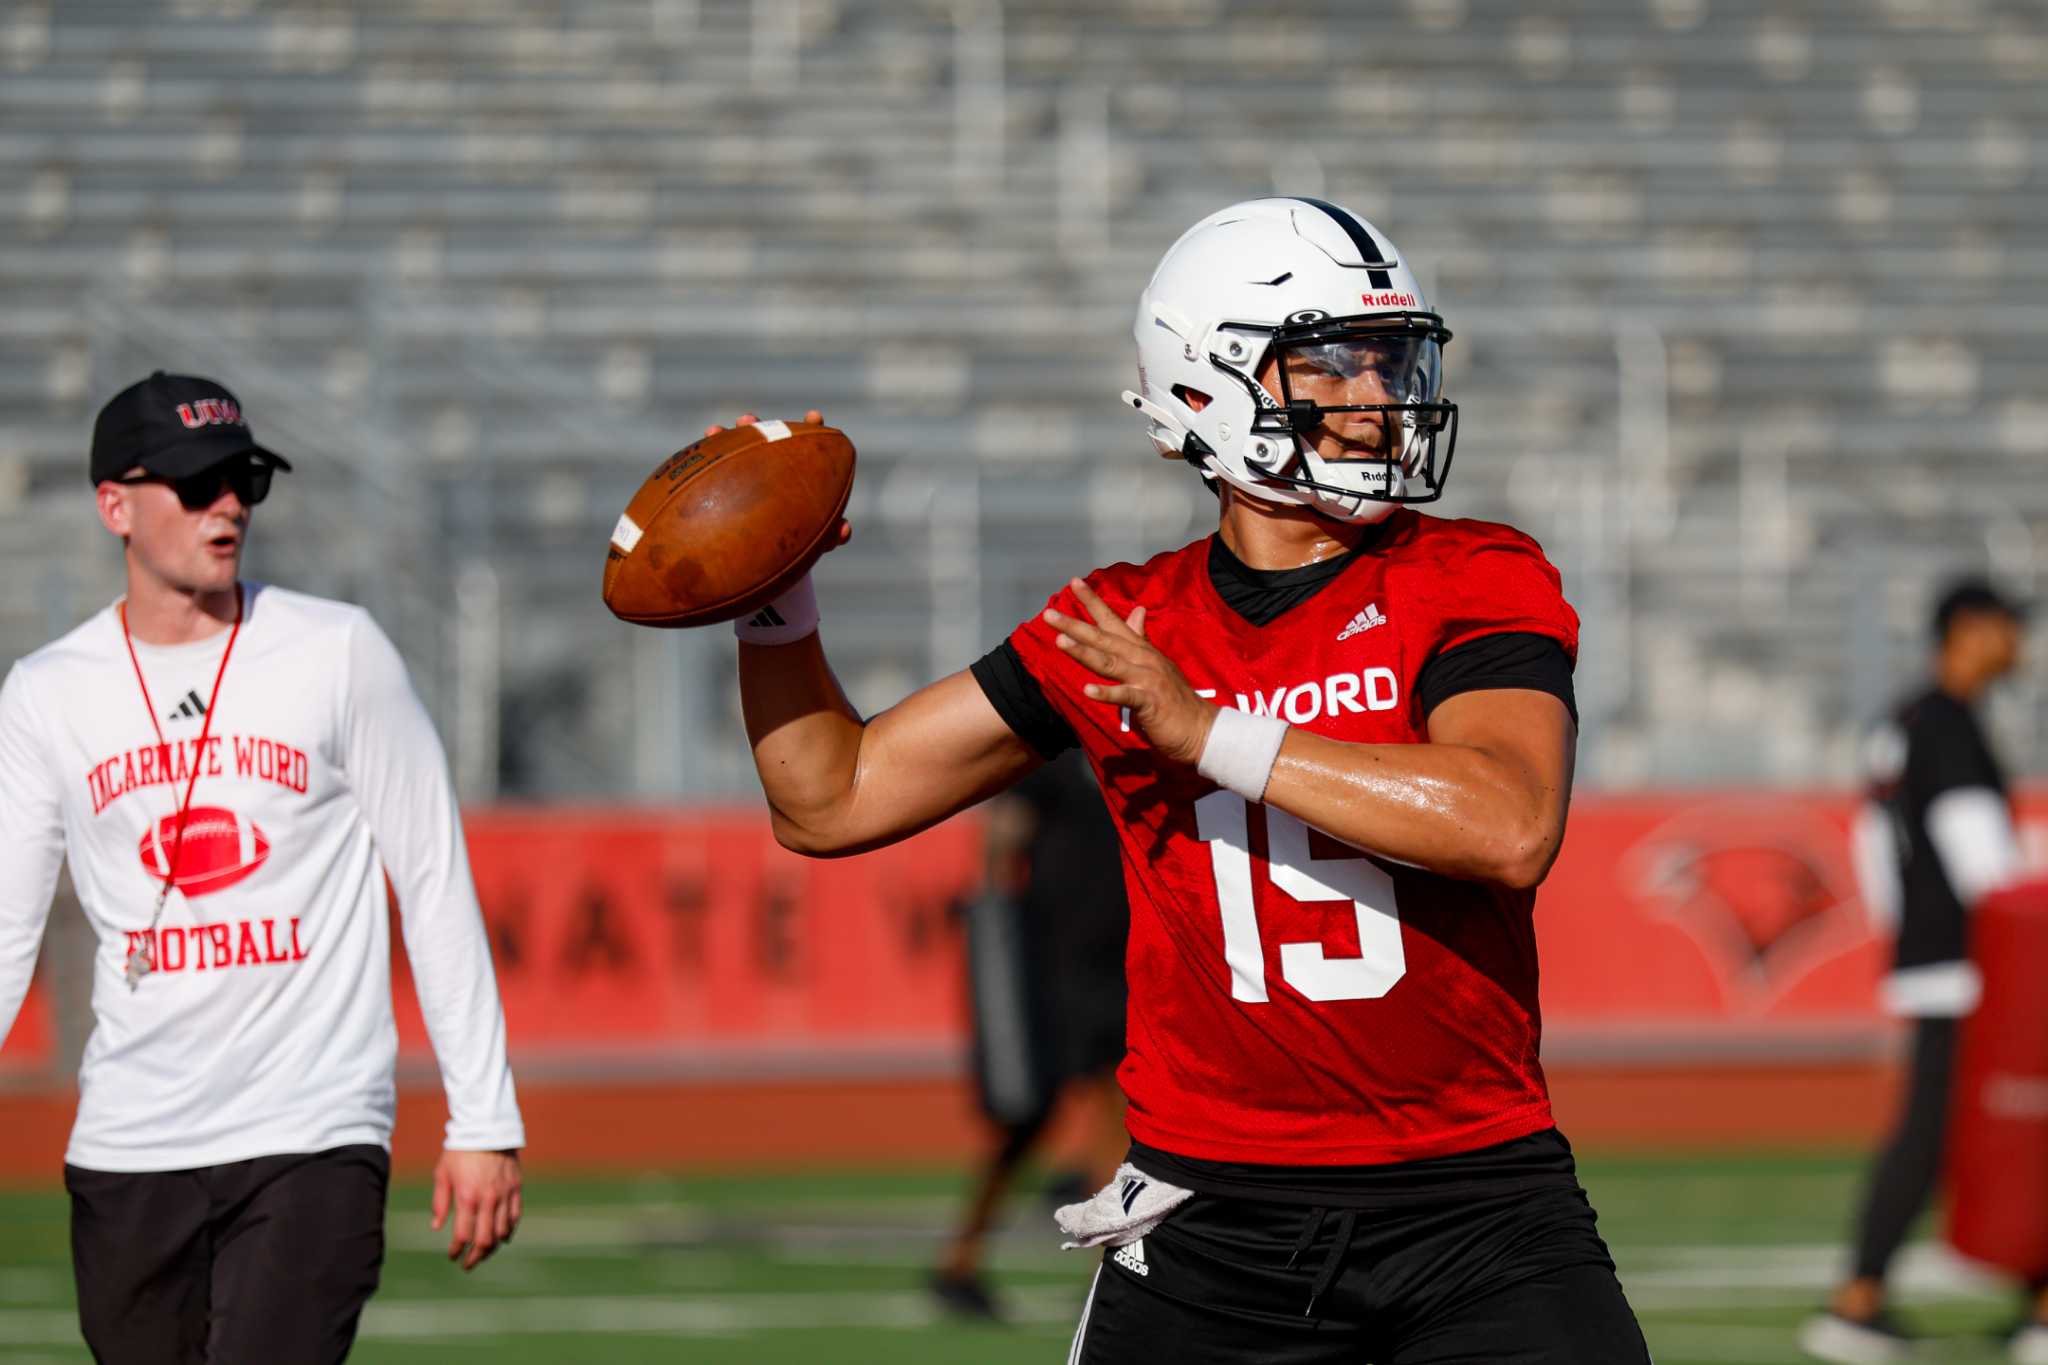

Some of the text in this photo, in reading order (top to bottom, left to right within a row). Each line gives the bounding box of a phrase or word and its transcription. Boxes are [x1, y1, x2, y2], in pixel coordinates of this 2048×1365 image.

[1361, 293, 1416, 306] Riddell
[1235, 667, 1398, 725] WORD
[232, 736, 308, 794] WORD
[1194, 789, 1407, 1003] 15
[1113, 1250, 1149, 1276] adidas
